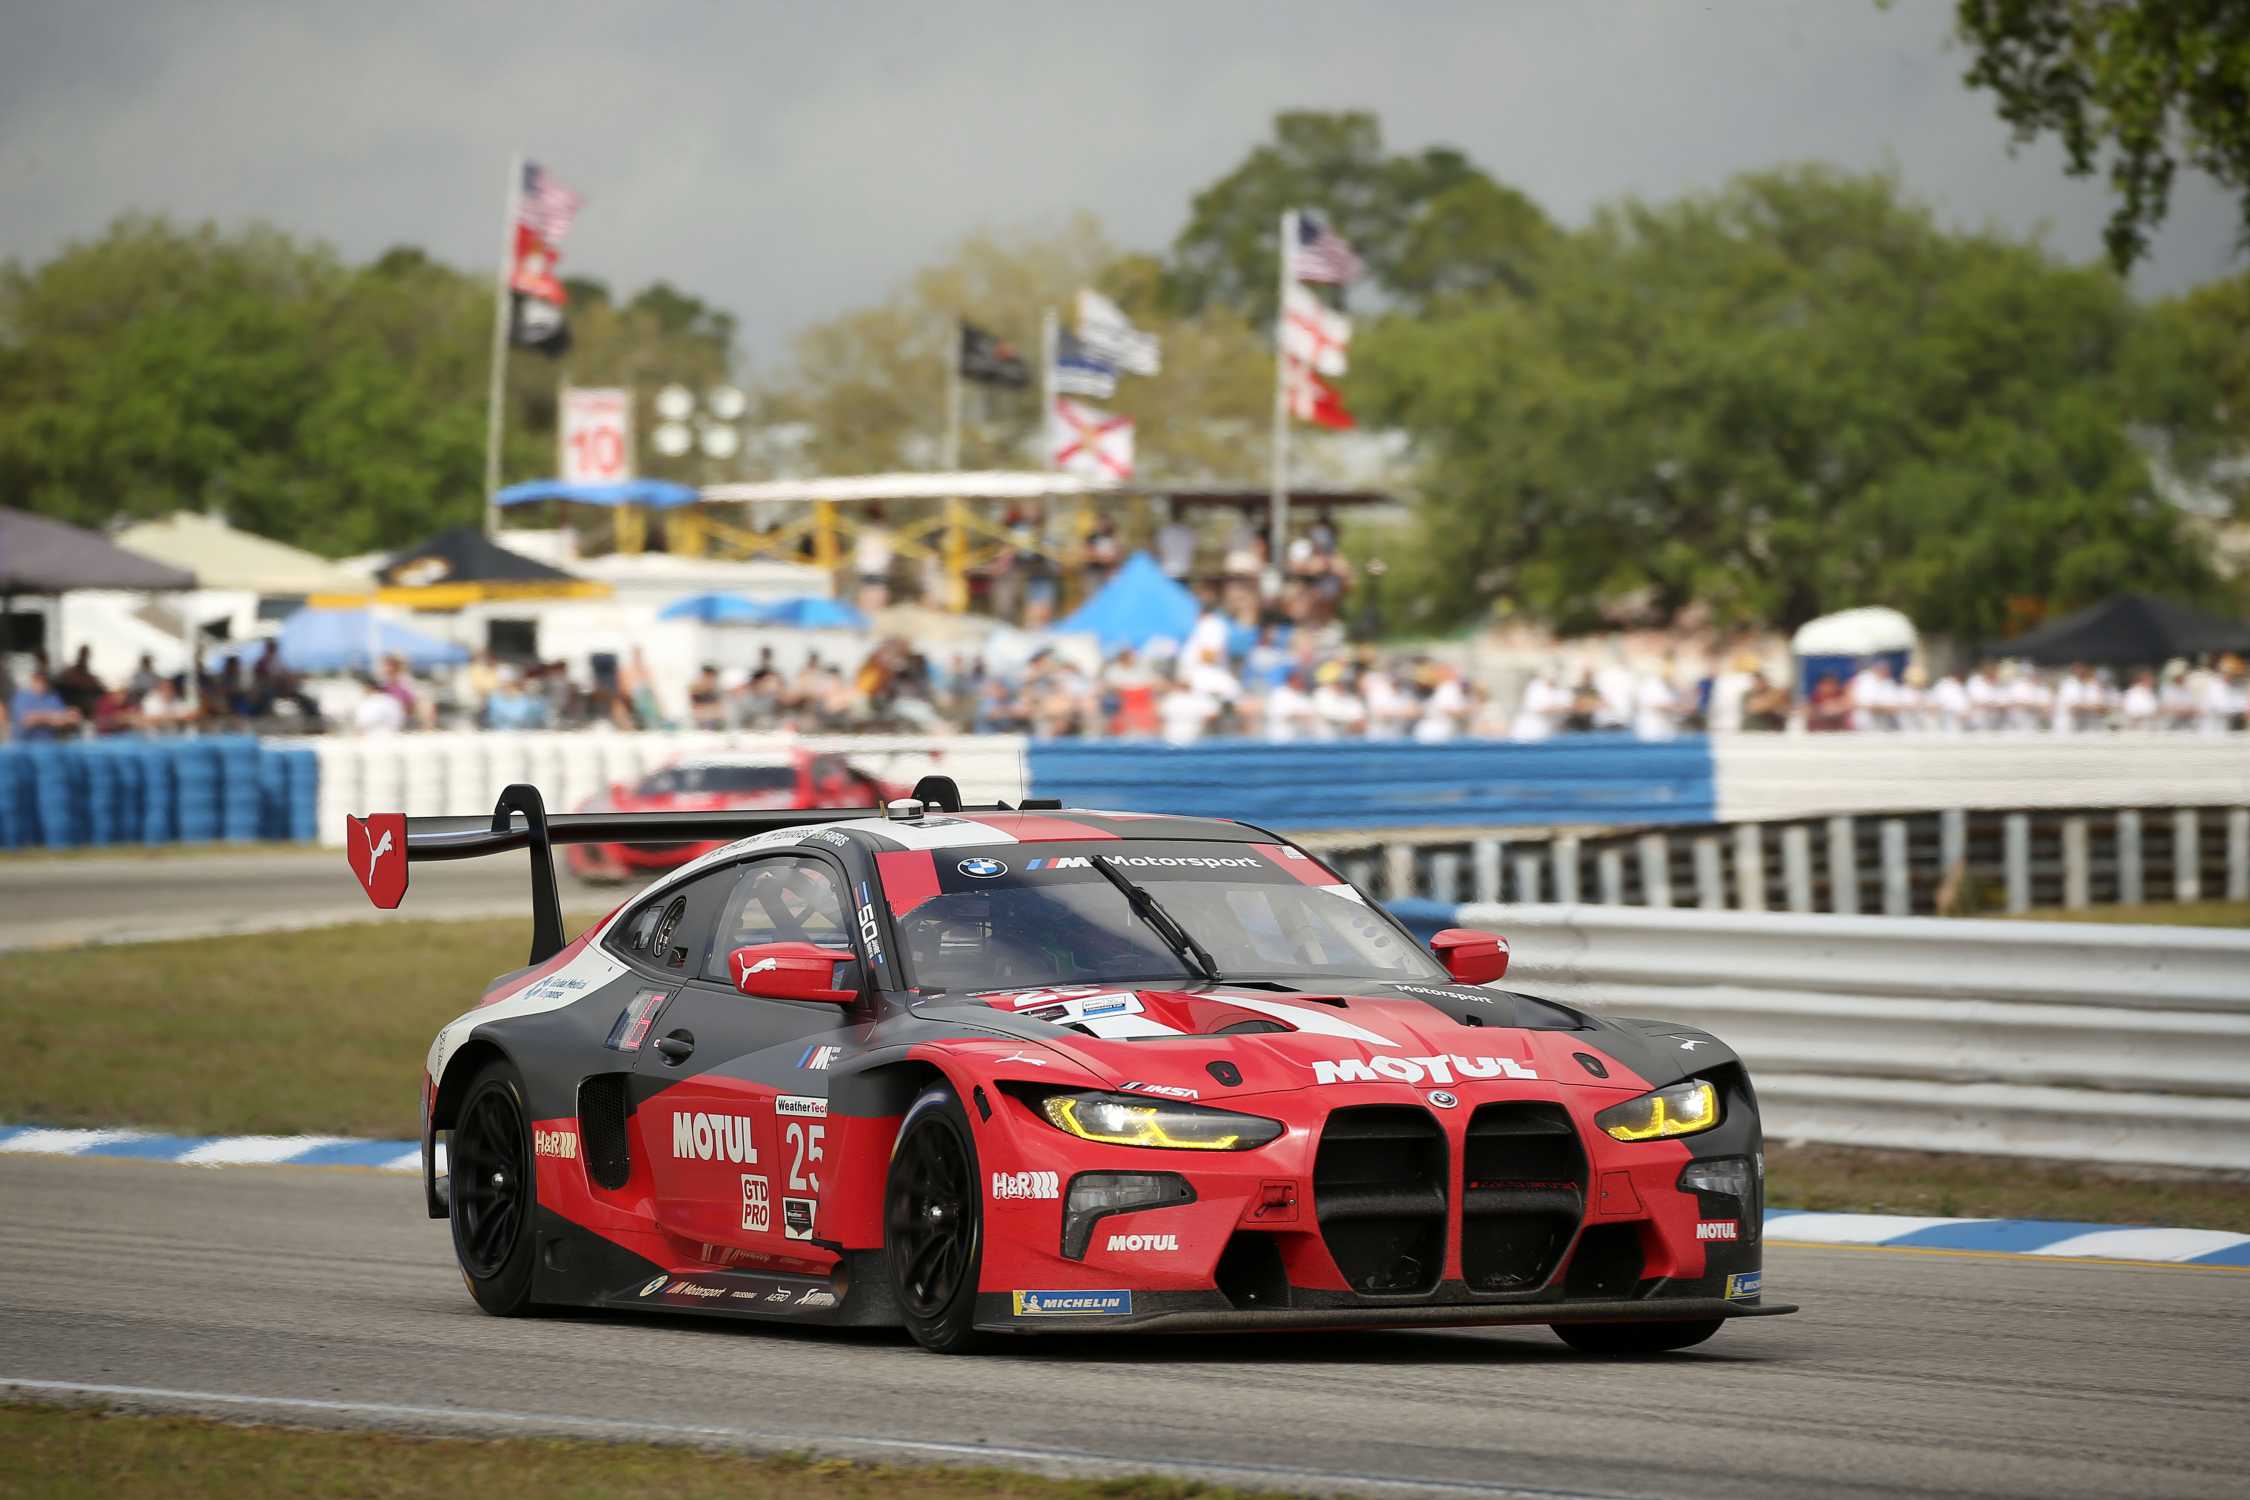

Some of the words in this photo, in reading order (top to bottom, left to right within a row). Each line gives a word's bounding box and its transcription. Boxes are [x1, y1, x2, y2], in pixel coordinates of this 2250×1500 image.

[1101, 856, 1263, 869] Motorsport
[858, 903, 878, 944] 50
[1395, 984, 1494, 1004] Motorsport
[1312, 1053, 1538, 1085] MOTUL
[1142, 1084, 1199, 1099] IMSA
[672, 1111, 758, 1164] MOTUL
[743, 1178, 768, 1202] GTD
[992, 1171, 1034, 1200] H&R
[743, 1202, 769, 1226] PRO
[1695, 1222, 1737, 1239] MOTUL
[1106, 1234, 1179, 1252] MOTUL
[1042, 1297, 1120, 1309] MICHELIN
